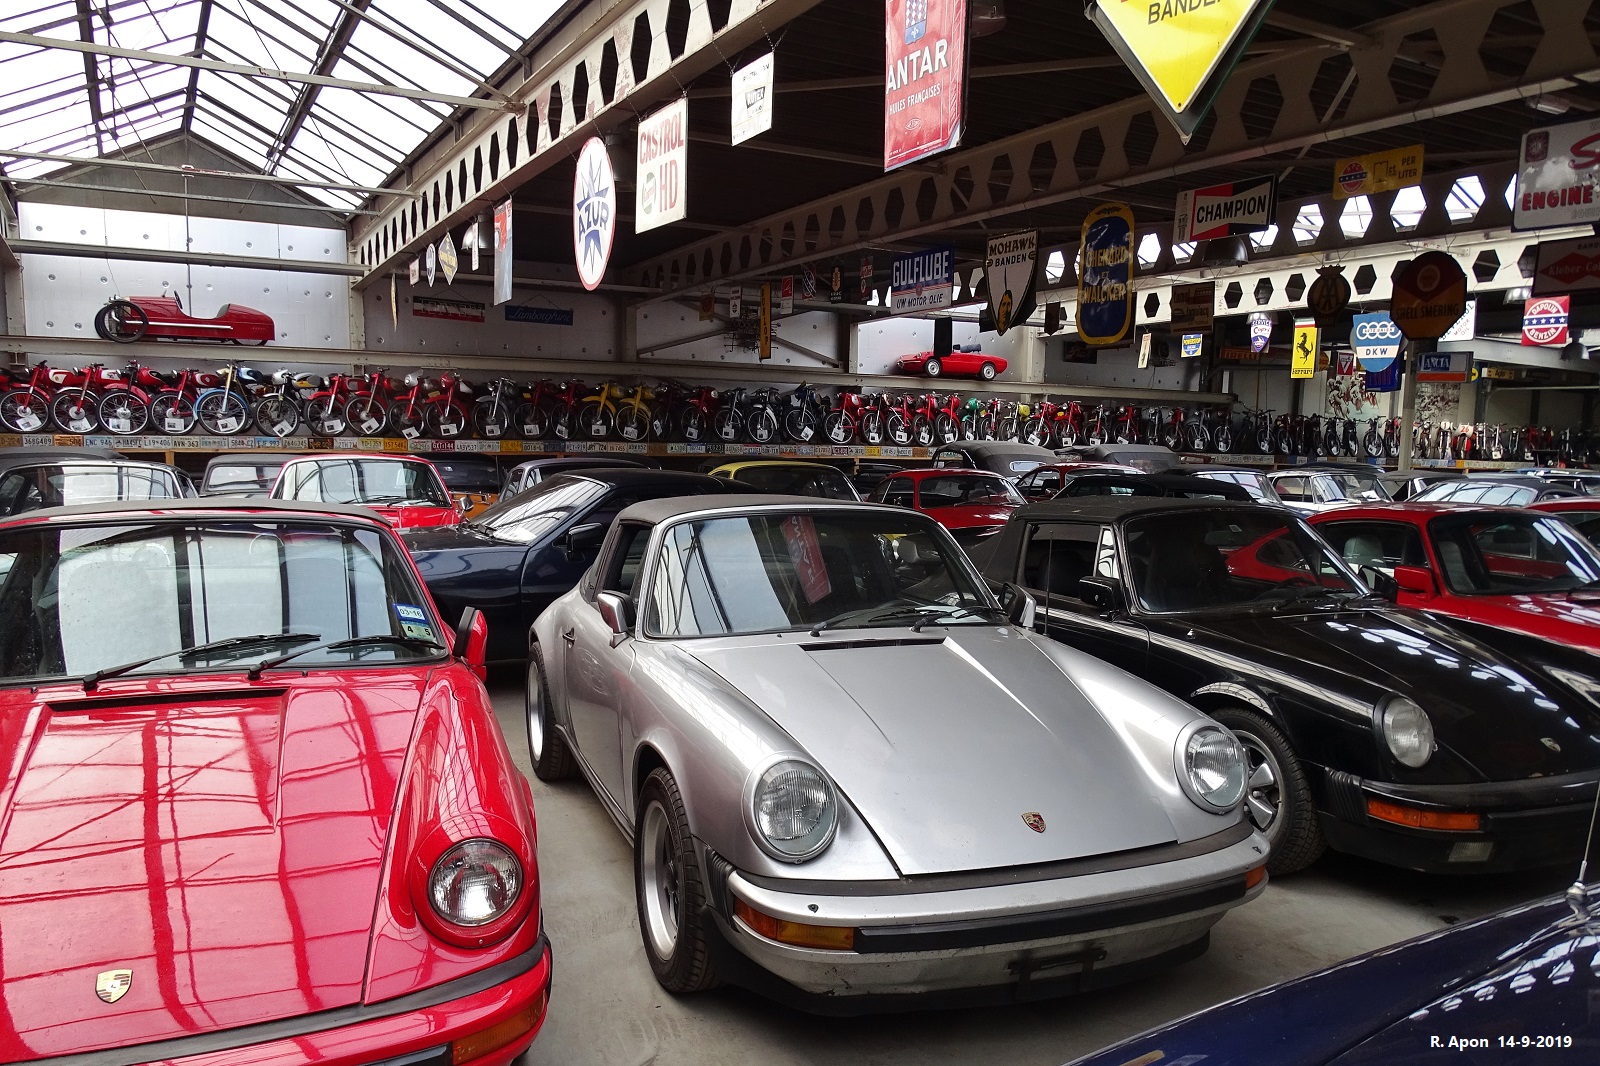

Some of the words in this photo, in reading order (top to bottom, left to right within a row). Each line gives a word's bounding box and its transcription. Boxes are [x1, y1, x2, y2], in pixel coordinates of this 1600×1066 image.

[1148, 0, 1221, 25] BAND
[886, 38, 948, 95] ANTAR
[889, 98, 906, 115] HUILES
[907, 83, 941, 107] FRANÇAISES
[639, 111, 684, 164] CASTROL
[1402, 156, 1416, 166] PER
[1398, 168, 1417, 179] LITER
[659, 159, 678, 212] HD
[1521, 184, 1594, 212] ENGINE
[1196, 194, 1267, 224] CHAMPION
[578, 200, 610, 244] AZUR
[989, 236, 1036, 257] MOHAWK
[1086, 246, 1129, 268] CHENARD
[893, 250, 950, 288] GULFLUBE
[995, 253, 1027, 267] BANDEN
[1101, 271, 1110, 279] ET
[907, 295, 927, 307] MOTOR
[928, 293, 943, 305] OLIE
[1081, 283, 1127, 304] WALCKER
[509, 307, 571, 322] Lamborghini
[1396, 306, 1418, 321] SHELL
[1419, 303, 1459, 319] SMERING
[1532, 303, 1558, 315] DAPOLIN
[1530, 327, 1556, 340] BENZIN
[1460, 425, 1470, 433] 26
